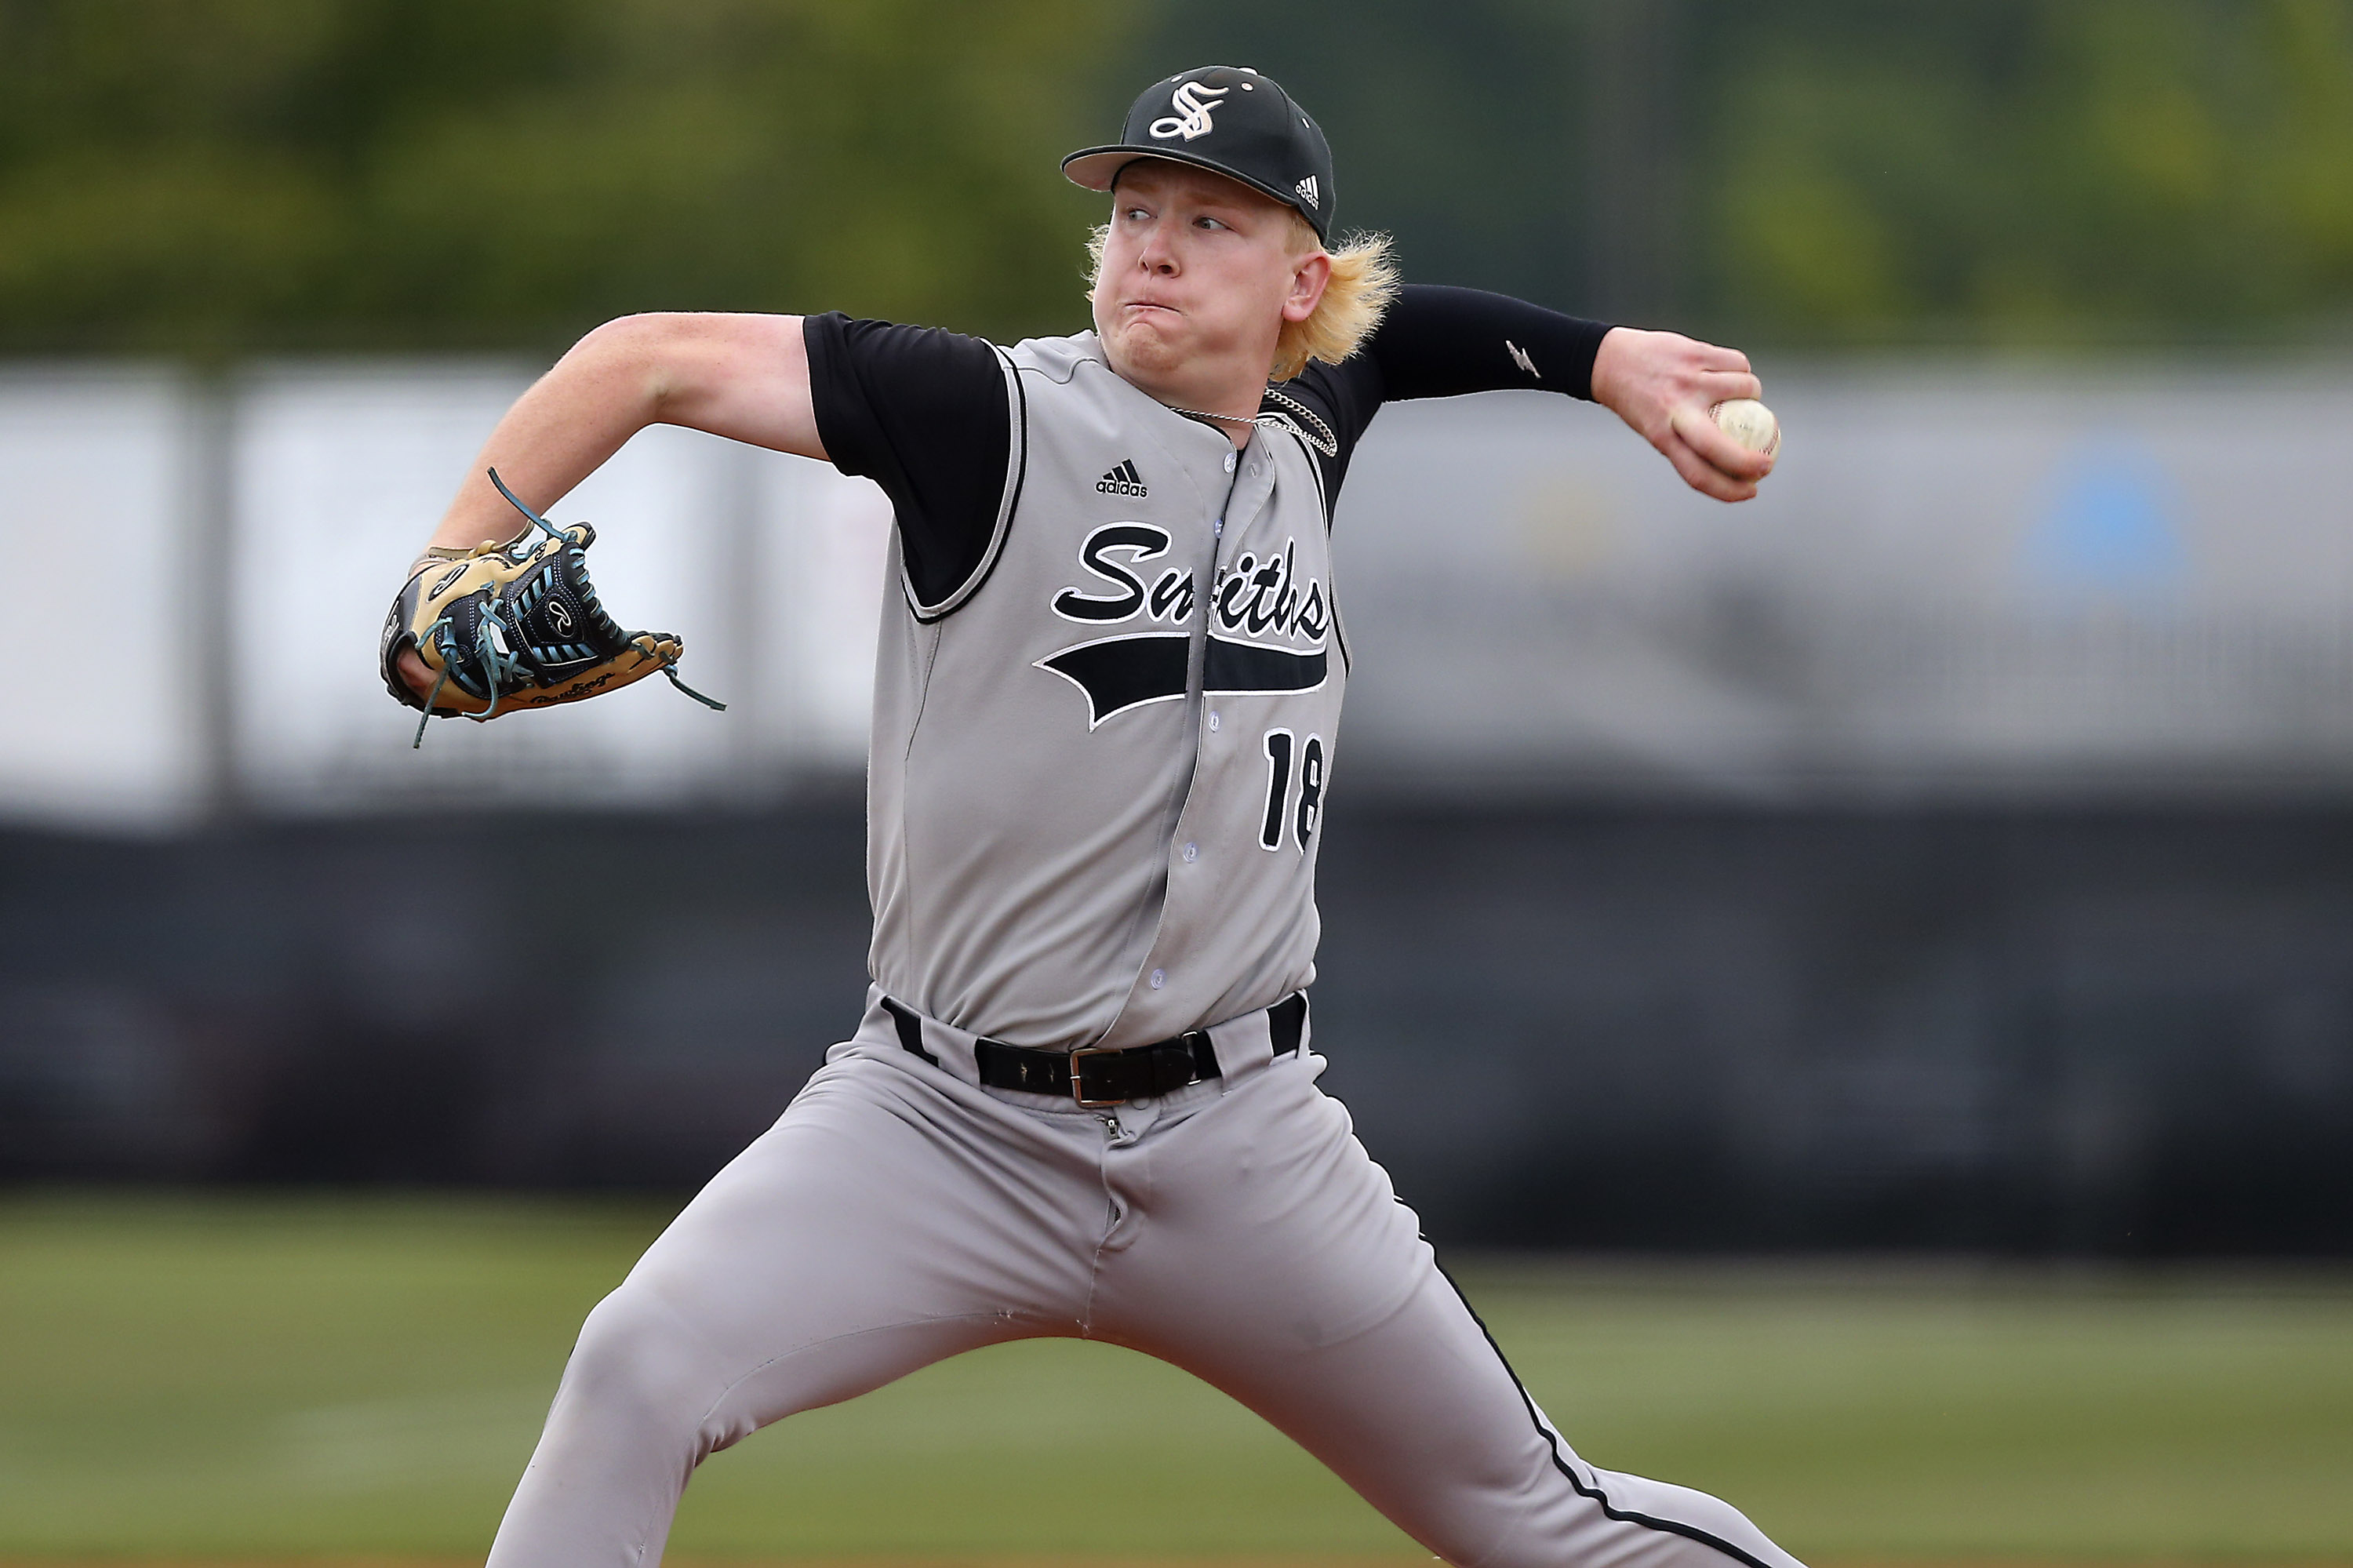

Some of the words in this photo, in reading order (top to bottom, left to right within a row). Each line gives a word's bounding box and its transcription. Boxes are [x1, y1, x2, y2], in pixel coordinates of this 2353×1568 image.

[1149, 81, 1229, 141] S
[1296, 184, 1319, 210] adidas
[1095, 480, 1147, 498] adidas
[549, 601, 572, 632] R
[1258, 727, 1324, 855] 18
